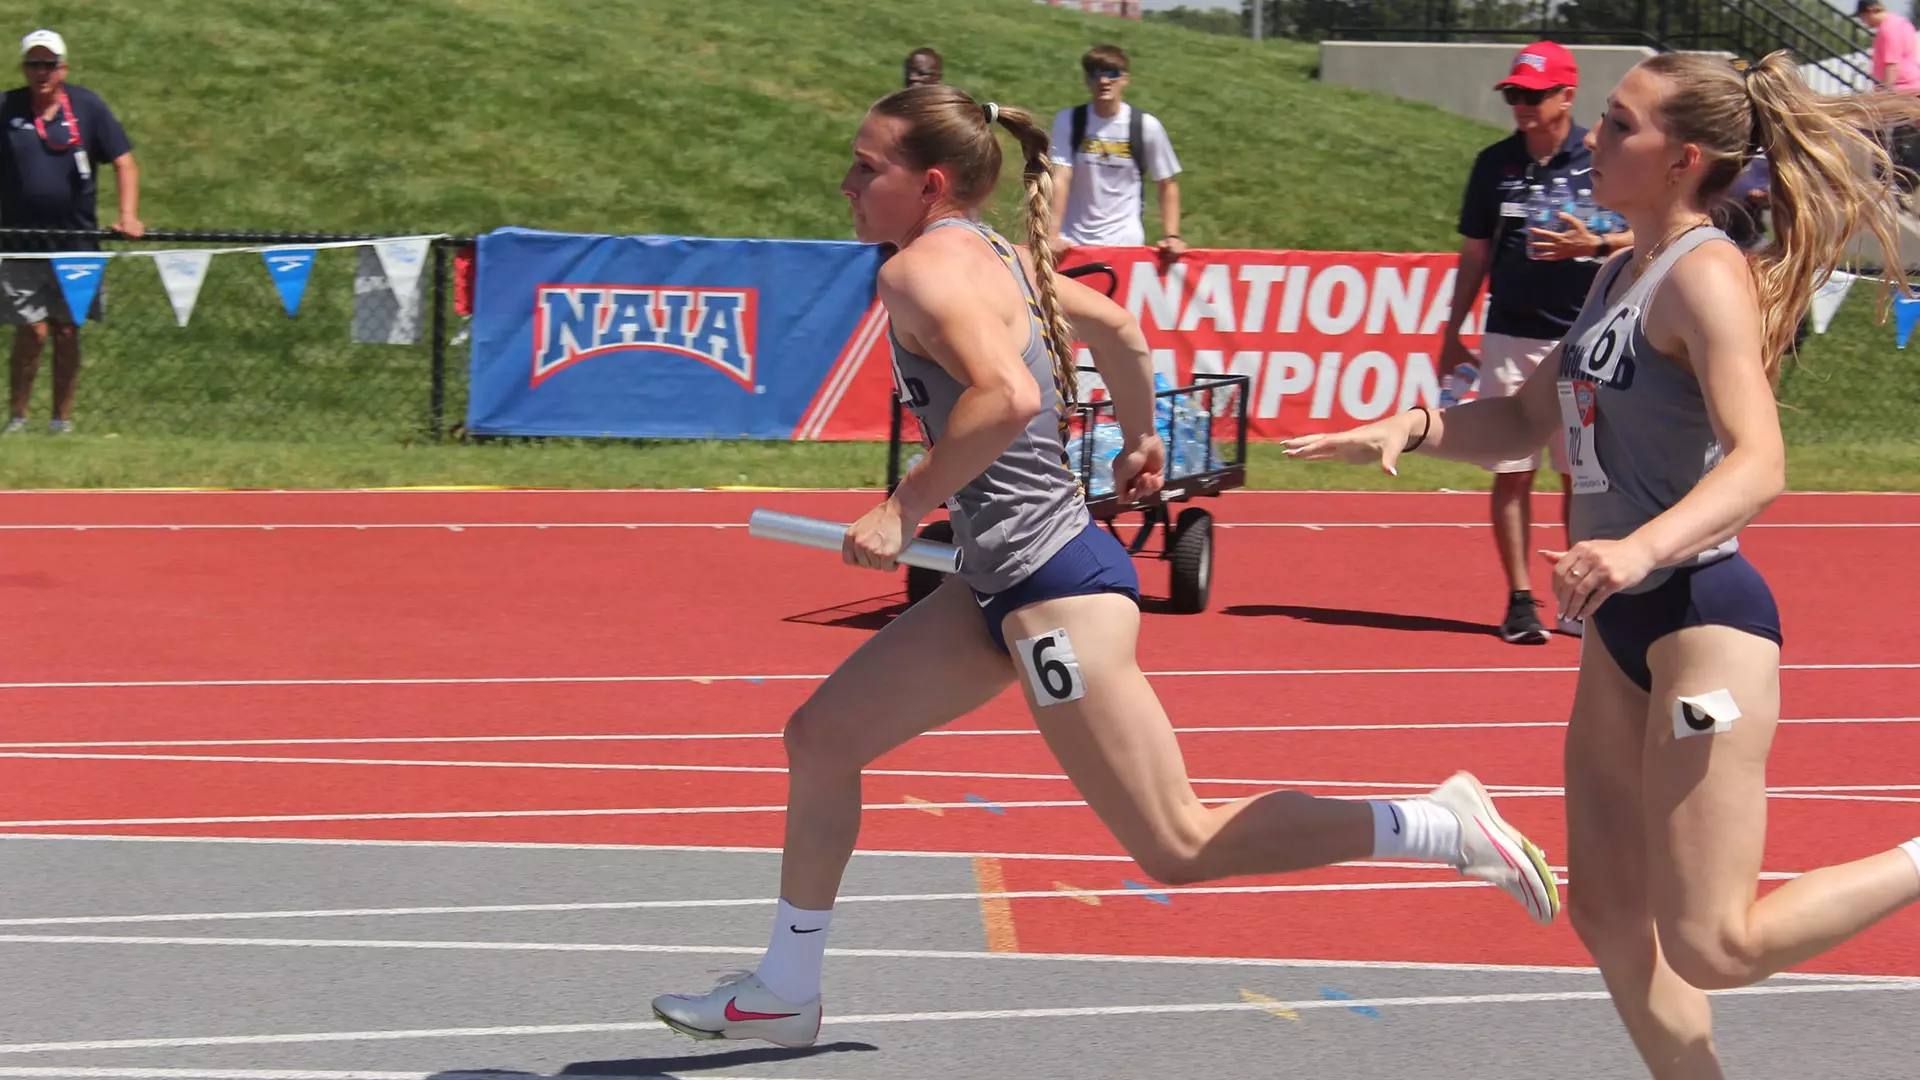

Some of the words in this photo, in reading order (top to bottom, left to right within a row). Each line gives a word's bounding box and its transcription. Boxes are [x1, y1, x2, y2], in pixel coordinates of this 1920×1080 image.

[532, 285, 754, 384] NAIA
[1588, 307, 1630, 371] 6
[1032, 636, 1073, 700] 6
